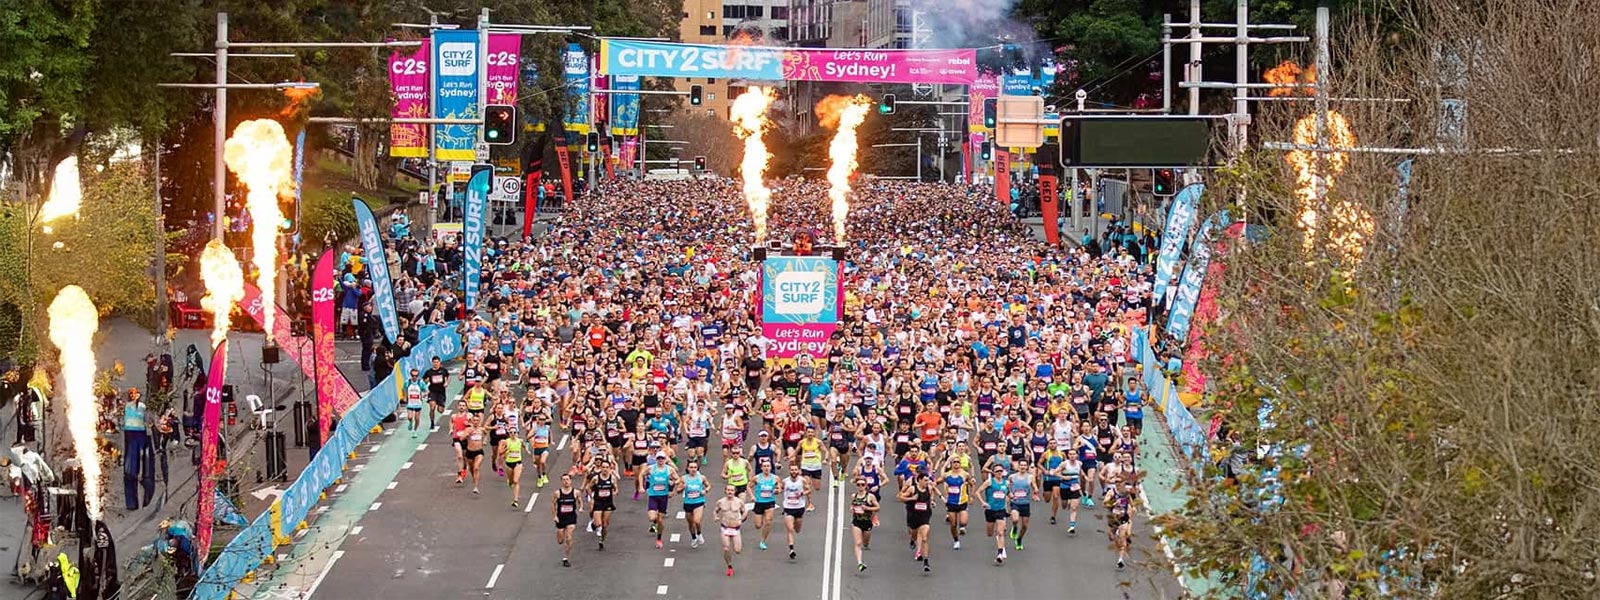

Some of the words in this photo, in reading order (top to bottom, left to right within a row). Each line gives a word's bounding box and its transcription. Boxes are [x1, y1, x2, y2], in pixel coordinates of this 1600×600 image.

[834, 51, 861, 61] Let's
[863, 51, 888, 61] Run
[948, 57, 970, 65] rebel
[825, 62, 896, 79] Sydney!
[394, 92, 427, 100] ydney!
[440, 88, 476, 98] Sydney!
[505, 182, 517, 190] 40
[782, 293, 818, 303] SURF
[775, 329, 800, 338] Let's
[802, 329, 824, 338] Run
